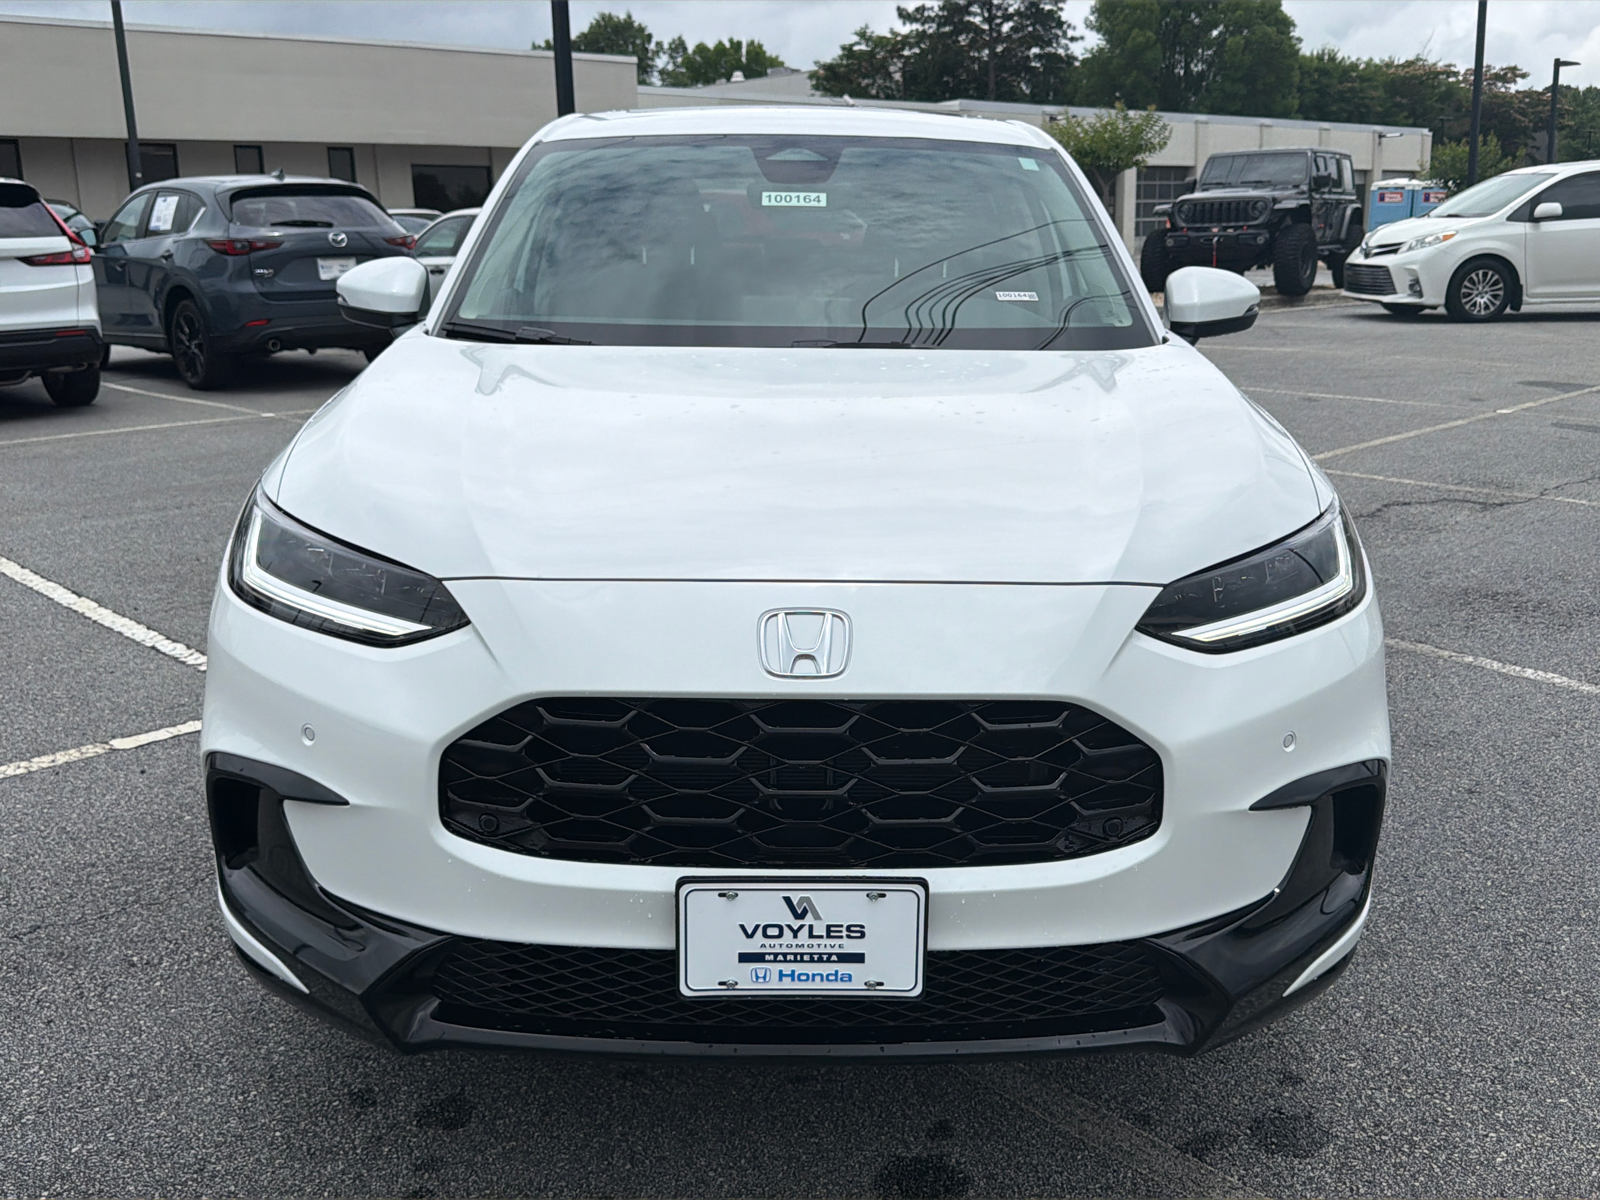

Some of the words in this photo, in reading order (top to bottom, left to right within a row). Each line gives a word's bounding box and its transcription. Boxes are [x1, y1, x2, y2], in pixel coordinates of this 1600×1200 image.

[765, 194, 822, 204] 100164
[738, 923, 866, 940] VOYLES
[778, 968, 853, 983] Honda
